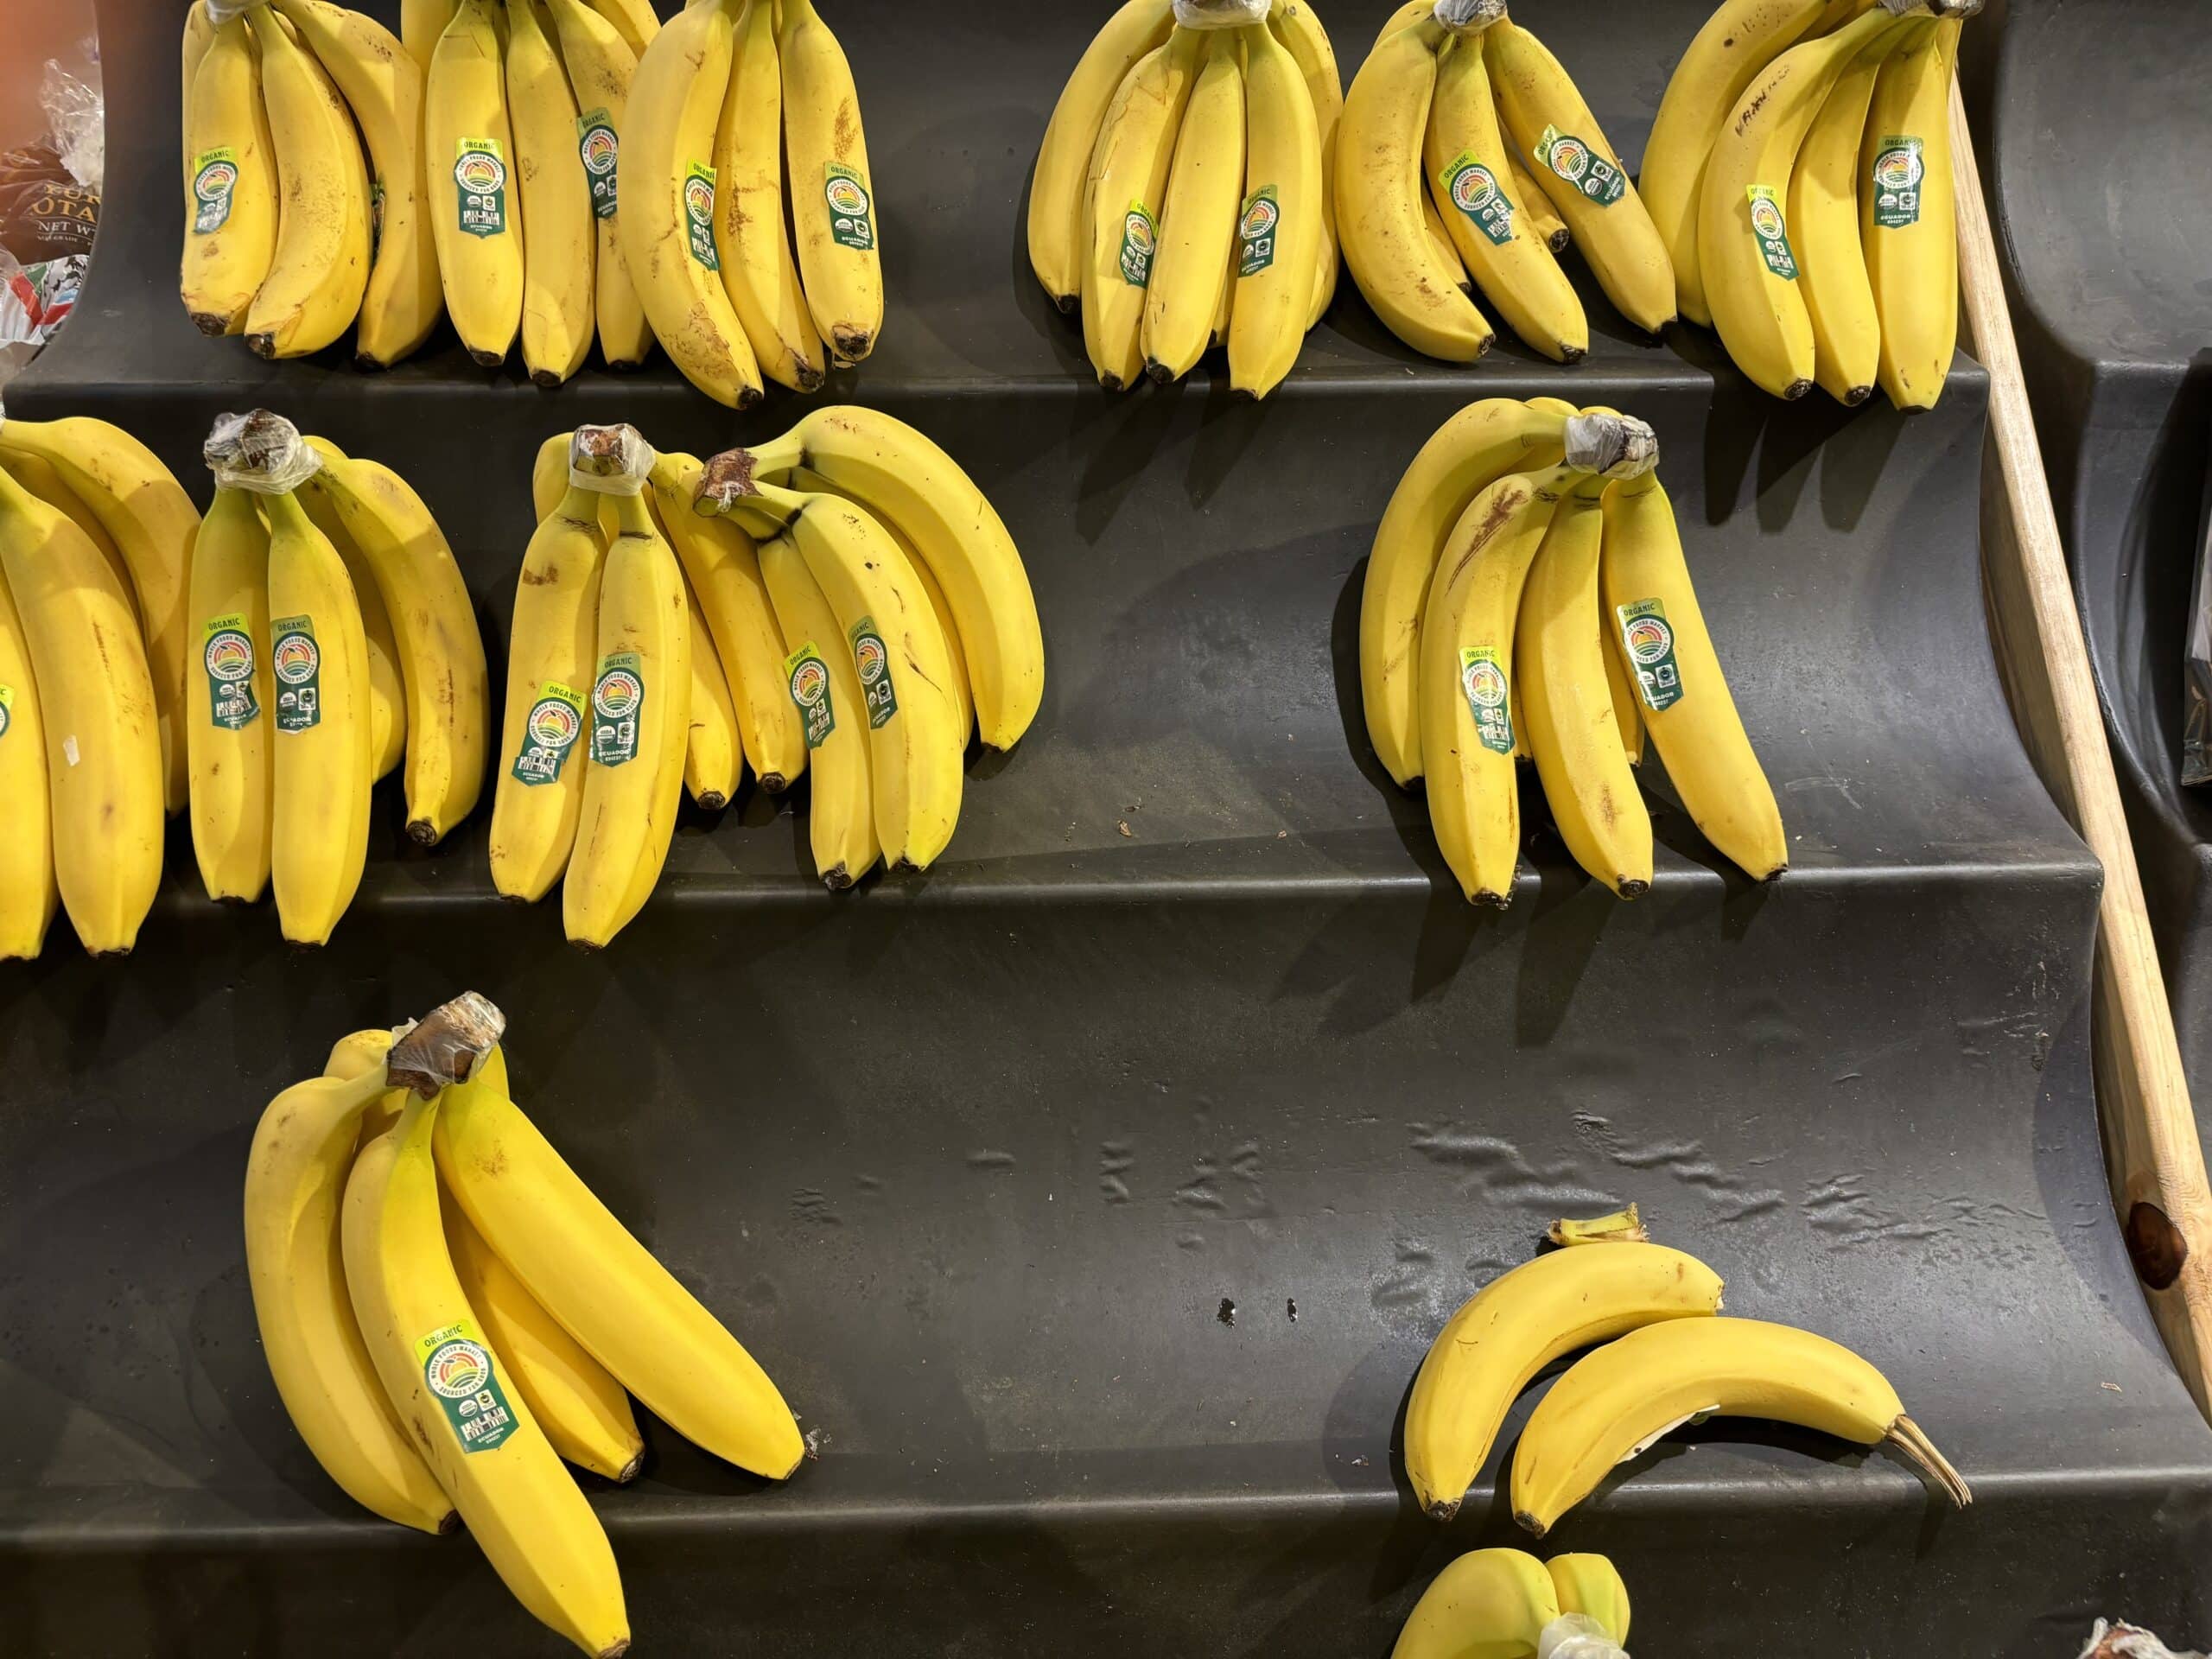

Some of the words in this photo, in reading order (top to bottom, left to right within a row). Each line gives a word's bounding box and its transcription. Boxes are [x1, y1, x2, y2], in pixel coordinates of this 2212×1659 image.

[582, 113, 605, 128] ORGANIC
[831, 167, 858, 179] ORGANIC
[1444, 154, 1469, 178] ORGANIC
[33, 197, 97, 223] OTA
[35, 220, 70, 232] NET
[1624, 603, 1656, 616] ORGANIC
[208, 618, 240, 631] ORGANIC
[277, 620, 308, 632] ORGANIC
[790, 645, 811, 665] ORGANIC
[604, 657, 632, 668] ORGANIC
[549, 686, 582, 703] ORGANIC
[424, 1325, 463, 1347] ORGANIC
